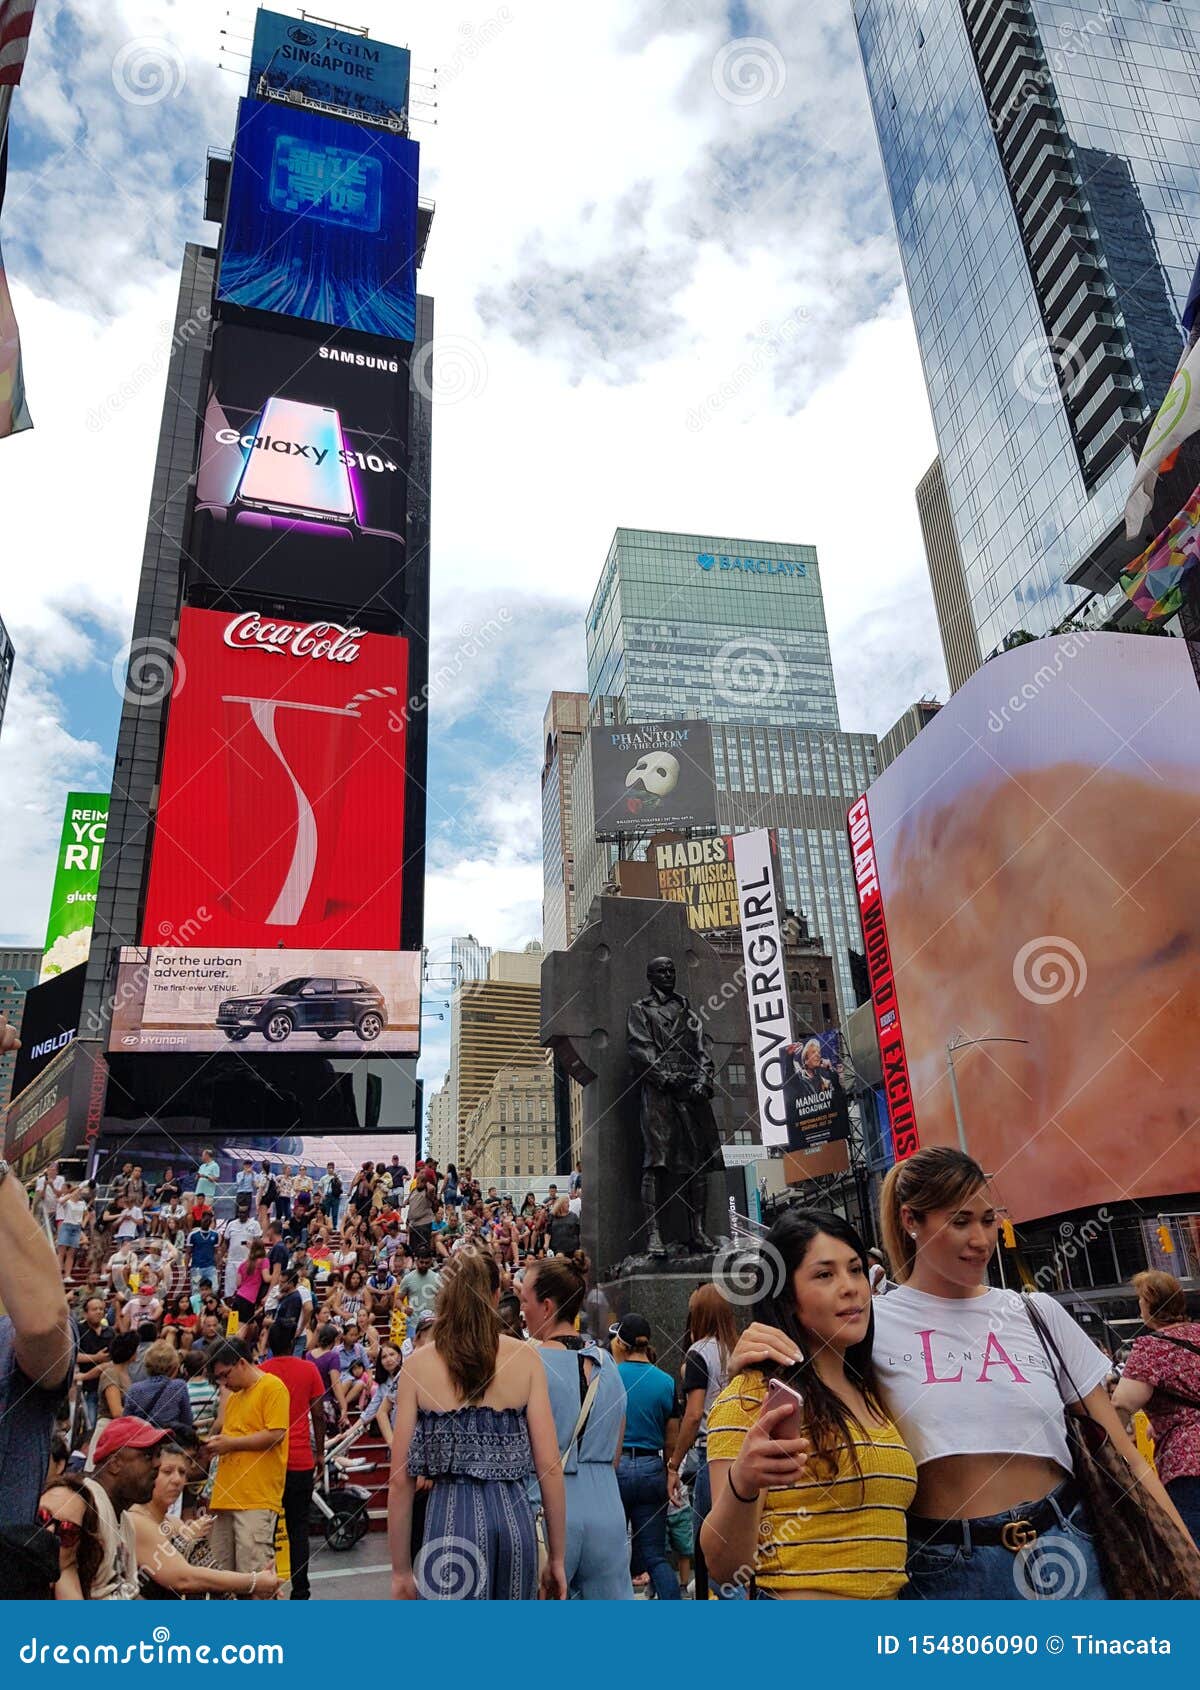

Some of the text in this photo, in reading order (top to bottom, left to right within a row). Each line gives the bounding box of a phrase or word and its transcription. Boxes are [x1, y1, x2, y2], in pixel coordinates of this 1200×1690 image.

[325, 37, 381, 63] PGIM
[282, 45, 375, 81] SINGAPORE
[319, 347, 399, 373] SAMSUNG
[215, 428, 397, 473] Galaxy S10+
[720, 556, 808, 577] BARCLAYS
[223, 611, 368, 663] Coca-Cola
[610, 729, 689, 745] PHANTOM
[652, 741, 682, 749] OPERA
[659, 868, 687, 889] BEST
[156, 955, 242, 966] For the urban
[862, 900, 893, 1006] WORLD
[154, 968, 230, 978] adventurer.
[153, 984, 169, 992] The
[170, 984, 206, 992] first-ever
[742, 866, 787, 1127] COVERGIRL
[30, 1028, 77, 1060] INGLOT
[141, 1036, 188, 1045] HYUNDAI
[795, 1090, 833, 1109] MANILOW
[799, 1101, 831, 1116] BROADWAY
[914, 1329, 1031, 1385] LA
